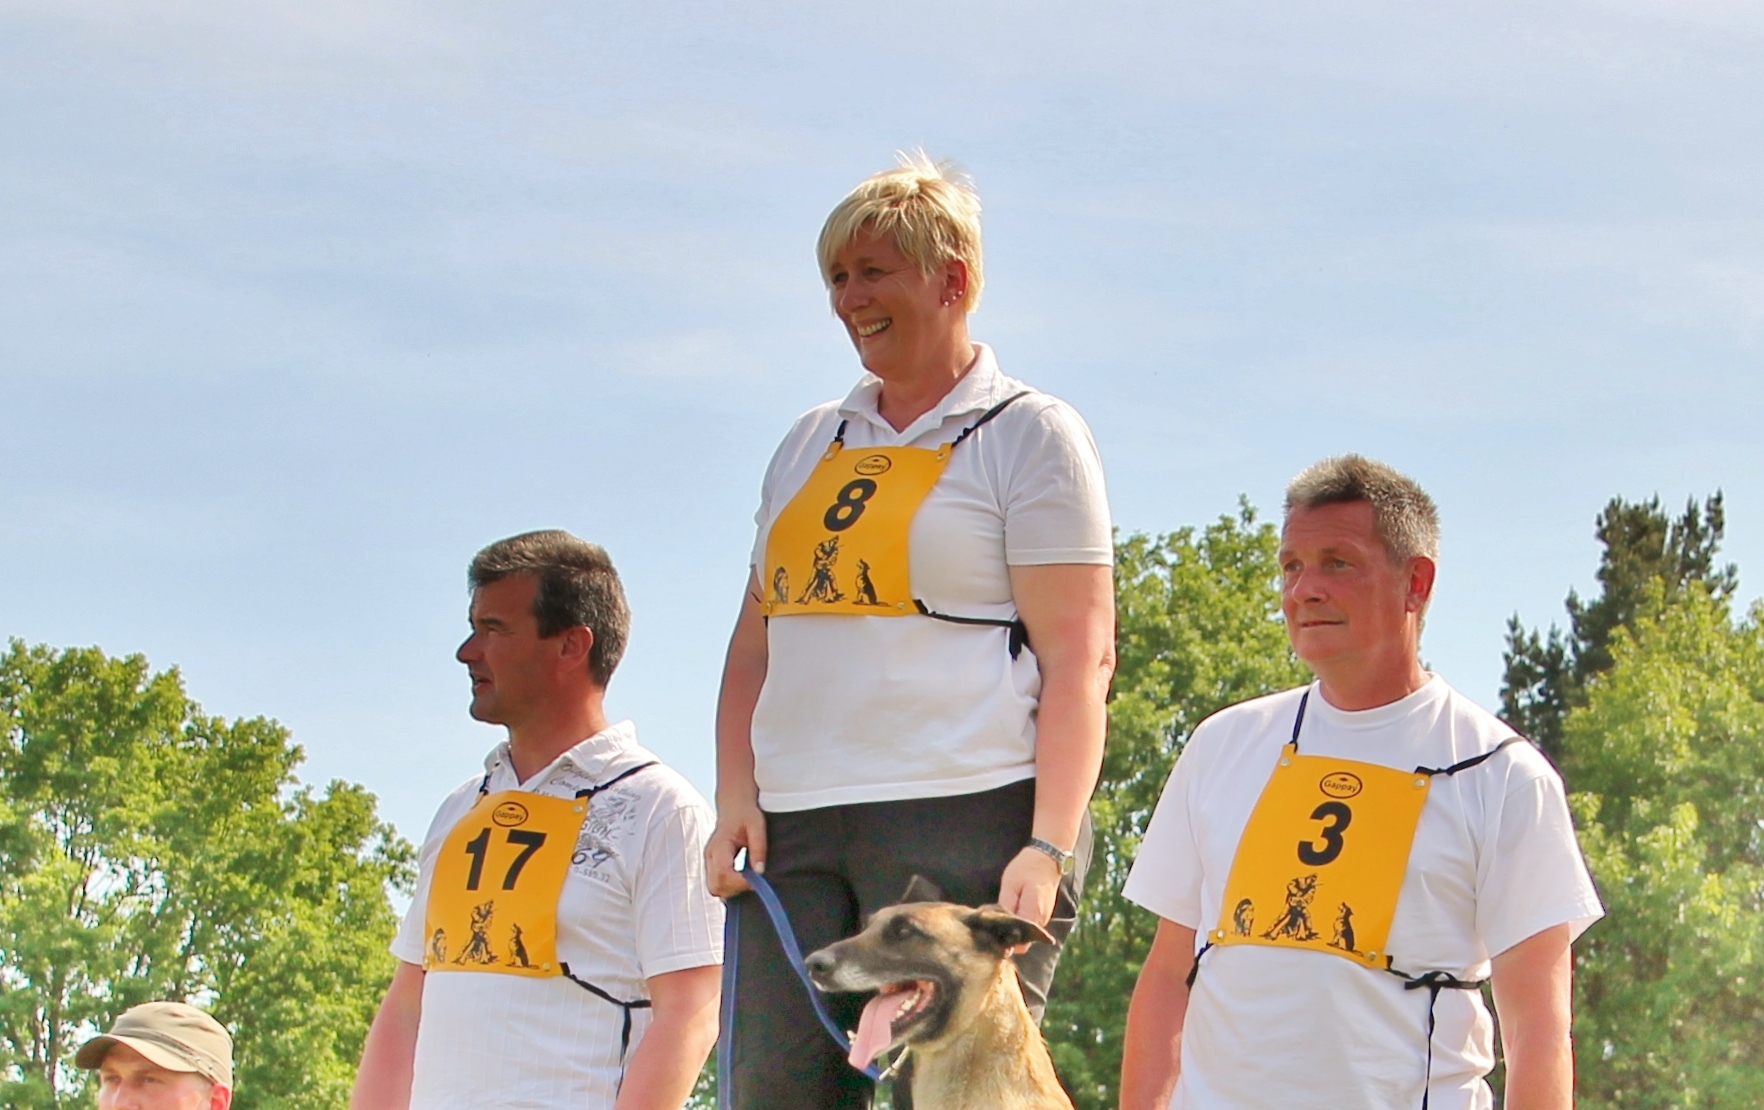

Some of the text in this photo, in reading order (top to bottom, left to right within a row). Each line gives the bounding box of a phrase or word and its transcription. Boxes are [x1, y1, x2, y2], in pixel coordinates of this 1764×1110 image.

[823, 478, 877, 532] 8
[1323, 779, 1359, 793] Gappay
[465, 827, 548, 891] 17
[1297, 801, 1353, 867] 3
